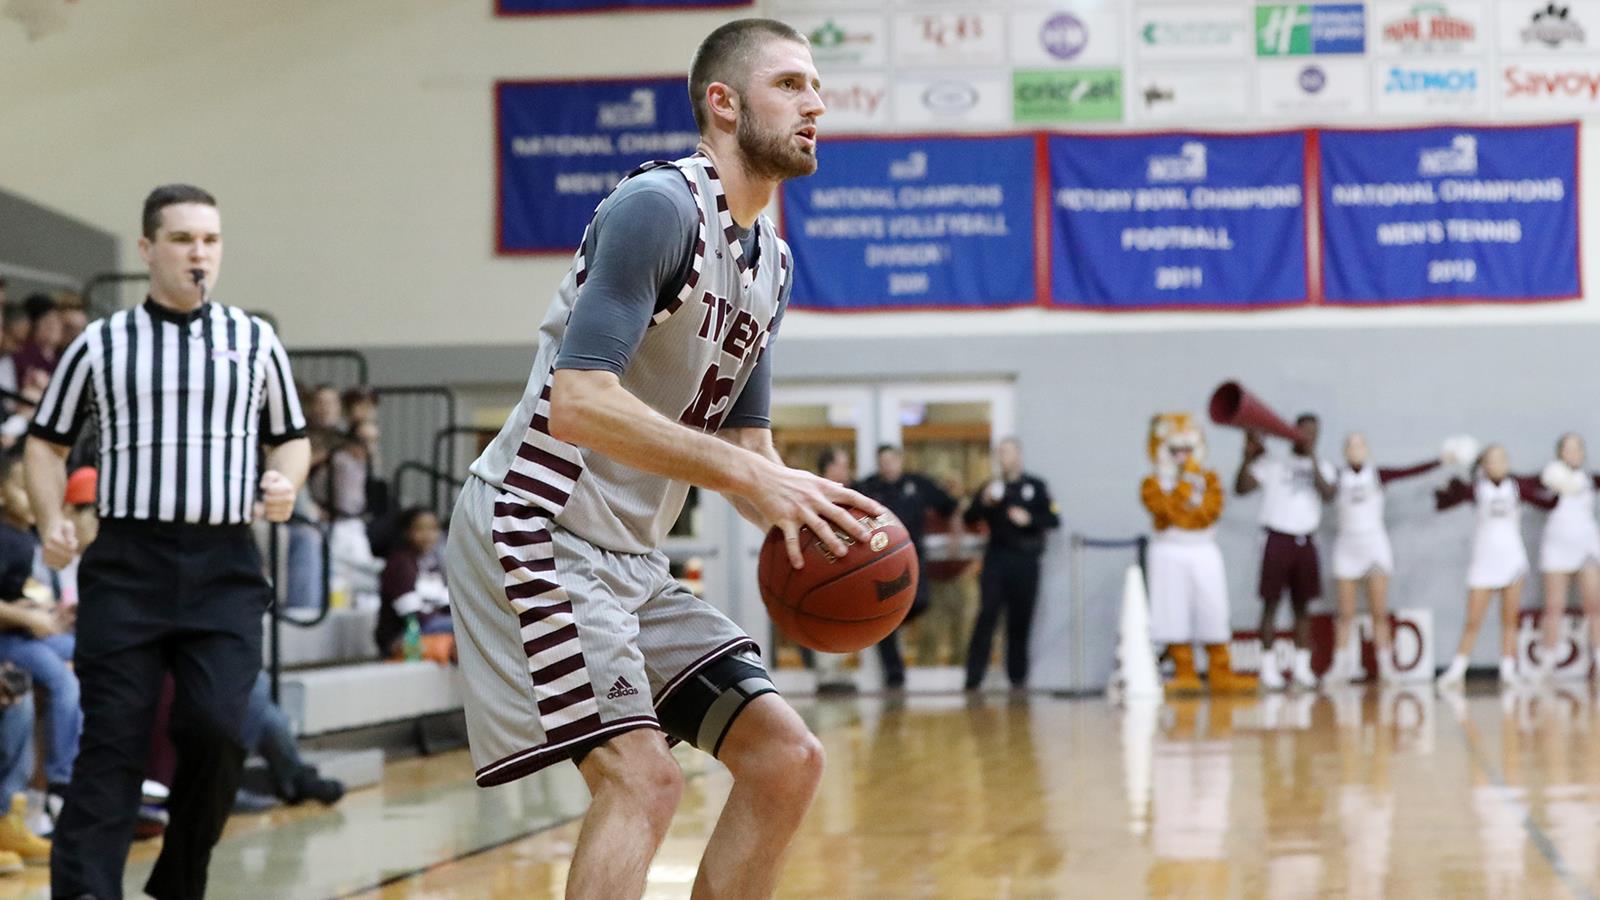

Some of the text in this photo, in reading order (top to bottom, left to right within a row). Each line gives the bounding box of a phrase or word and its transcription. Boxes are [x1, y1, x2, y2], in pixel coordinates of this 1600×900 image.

[811, 184, 1004, 210] NATIONAL CHAMPIONS
[1133, 187, 1189, 212] BOWL
[1190, 184, 1302, 210] CHAMPIONS
[1331, 177, 1566, 208] NATIONAL CHAMPIONS
[888, 212, 1009, 239] VOLLEYBALL
[1120, 226, 1234, 251] FOOTBALL
[1446, 217, 1523, 243] TENNIS
[607, 687, 639, 700] adidas
